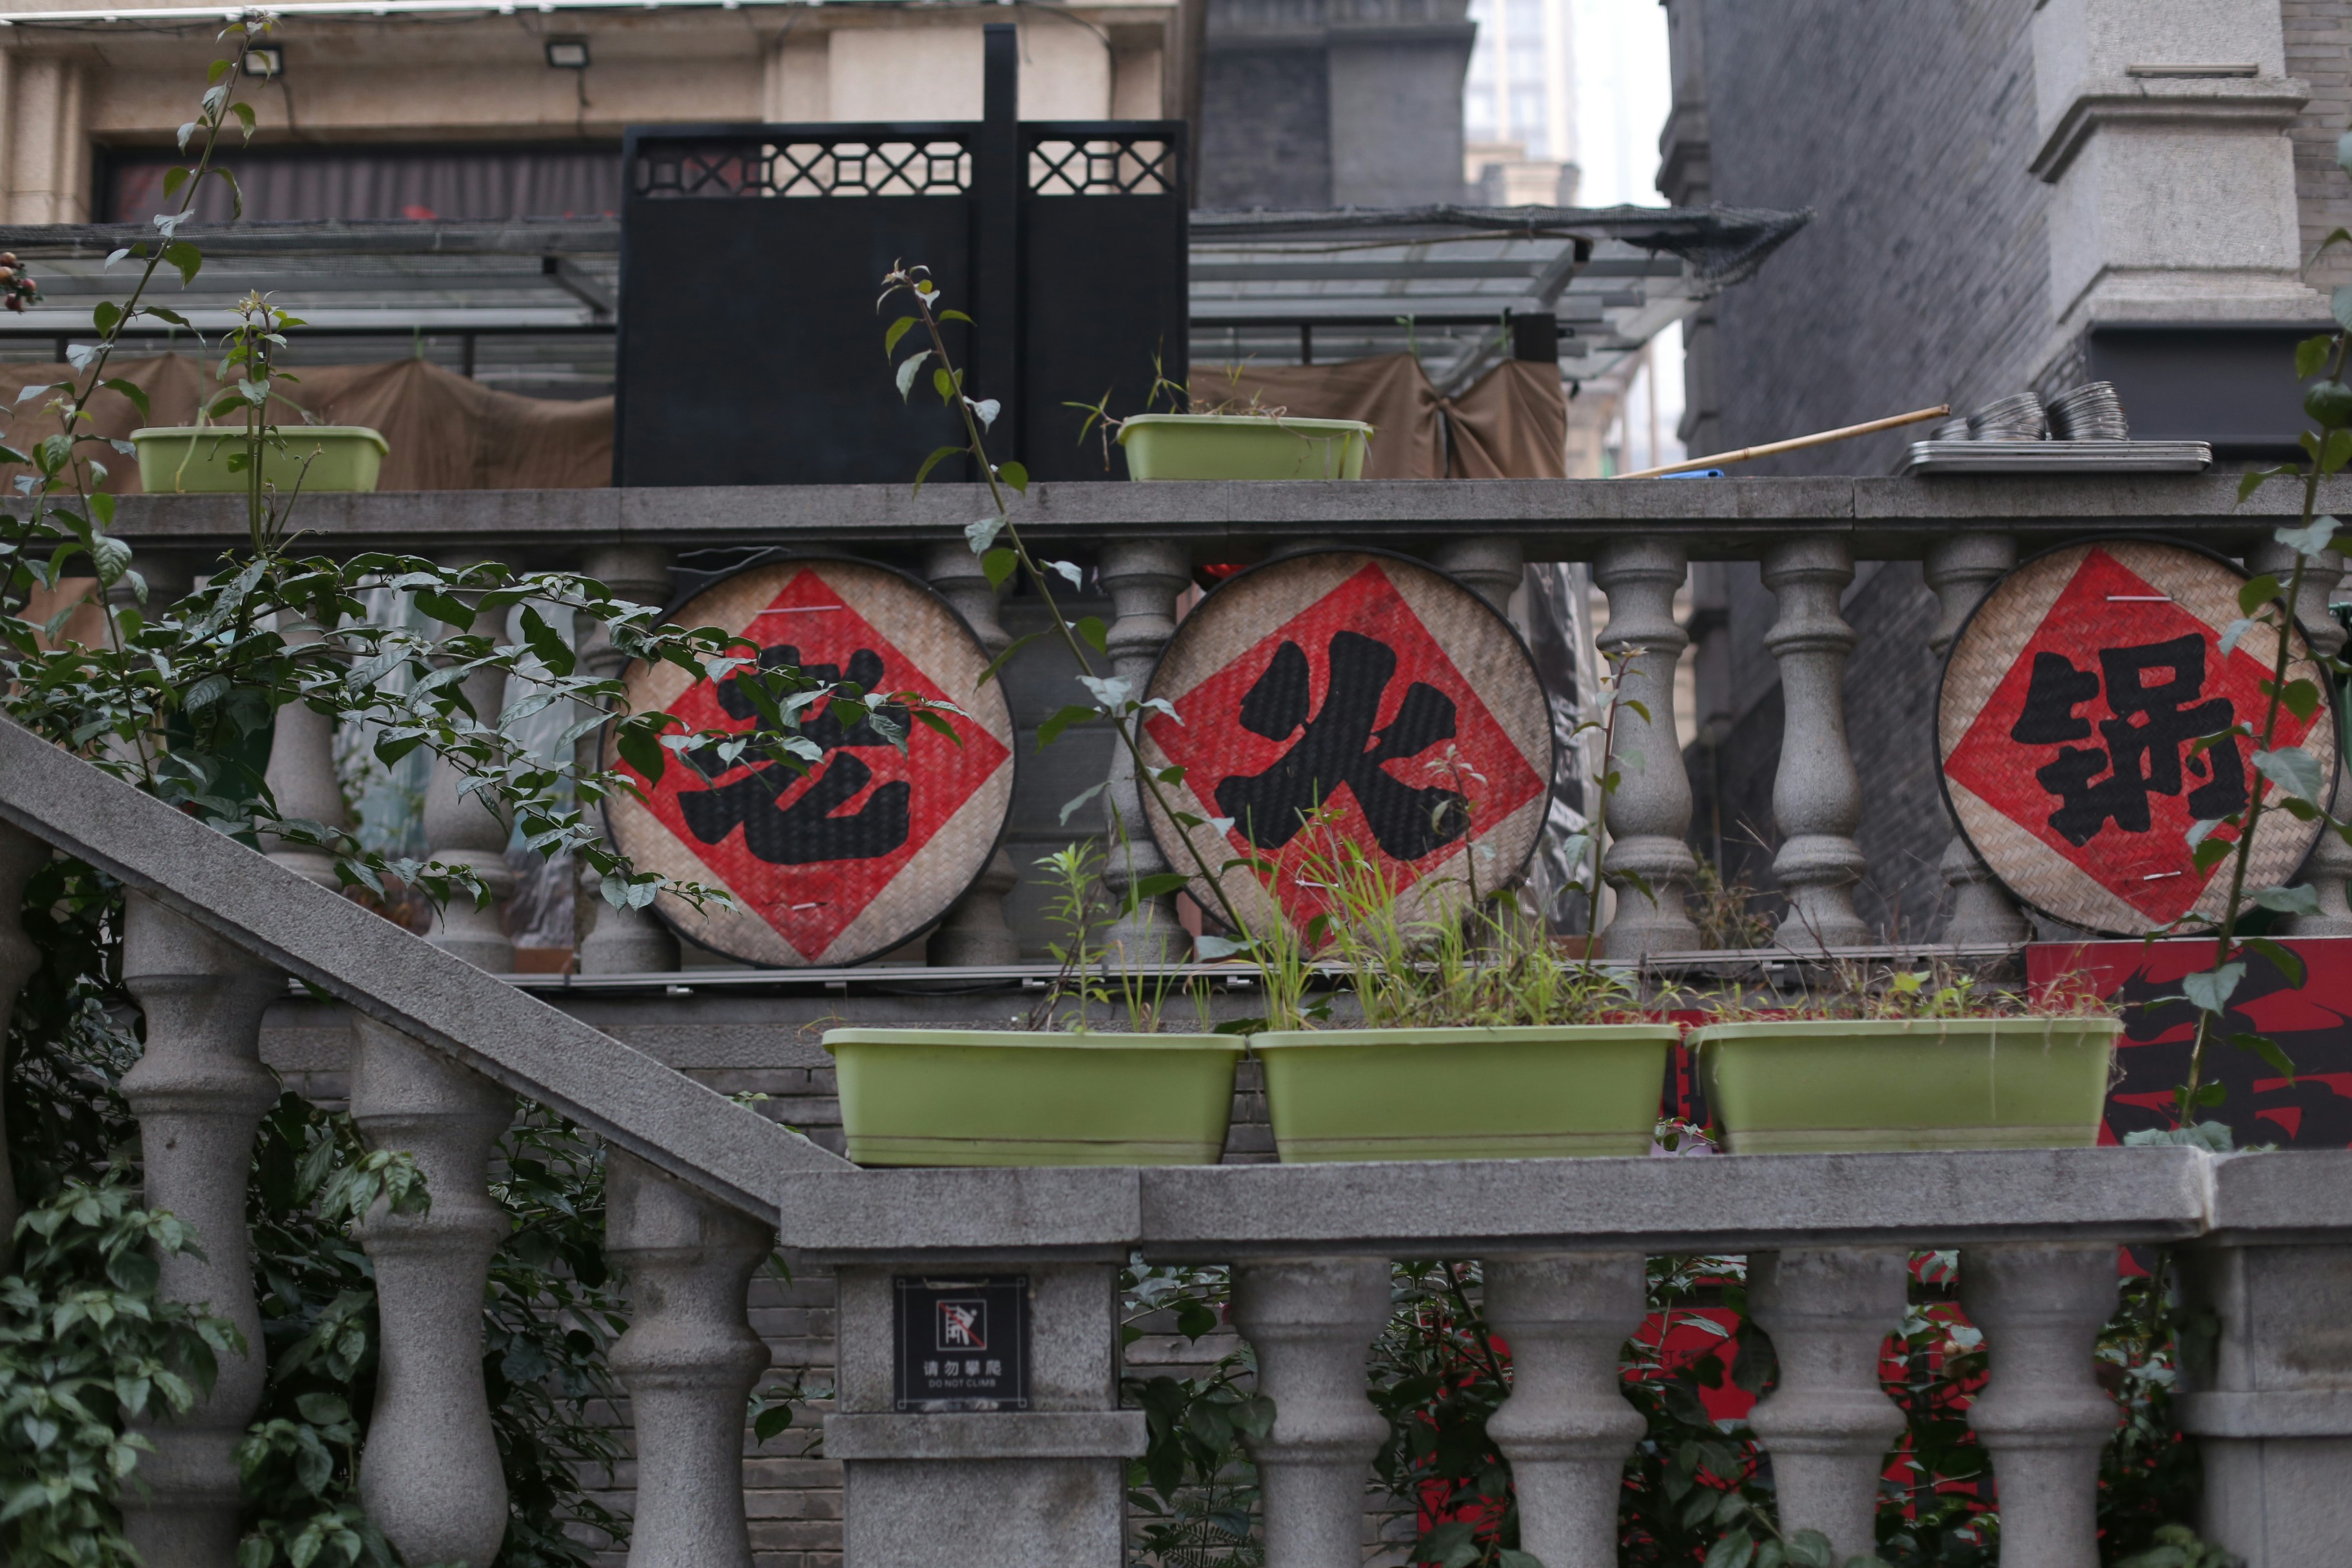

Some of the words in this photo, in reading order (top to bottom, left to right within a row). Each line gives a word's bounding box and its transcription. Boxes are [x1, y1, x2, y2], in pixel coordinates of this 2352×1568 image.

[677, 645, 912, 865] 老
[1213, 630, 1471, 861] 火
[2010, 632, 2250, 848] 锅
[923, 1360, 1002, 1377] 请勿攀爬
[945, 1379, 964, 1387] NOT
[966, 1378, 996, 1387] CLIMB
